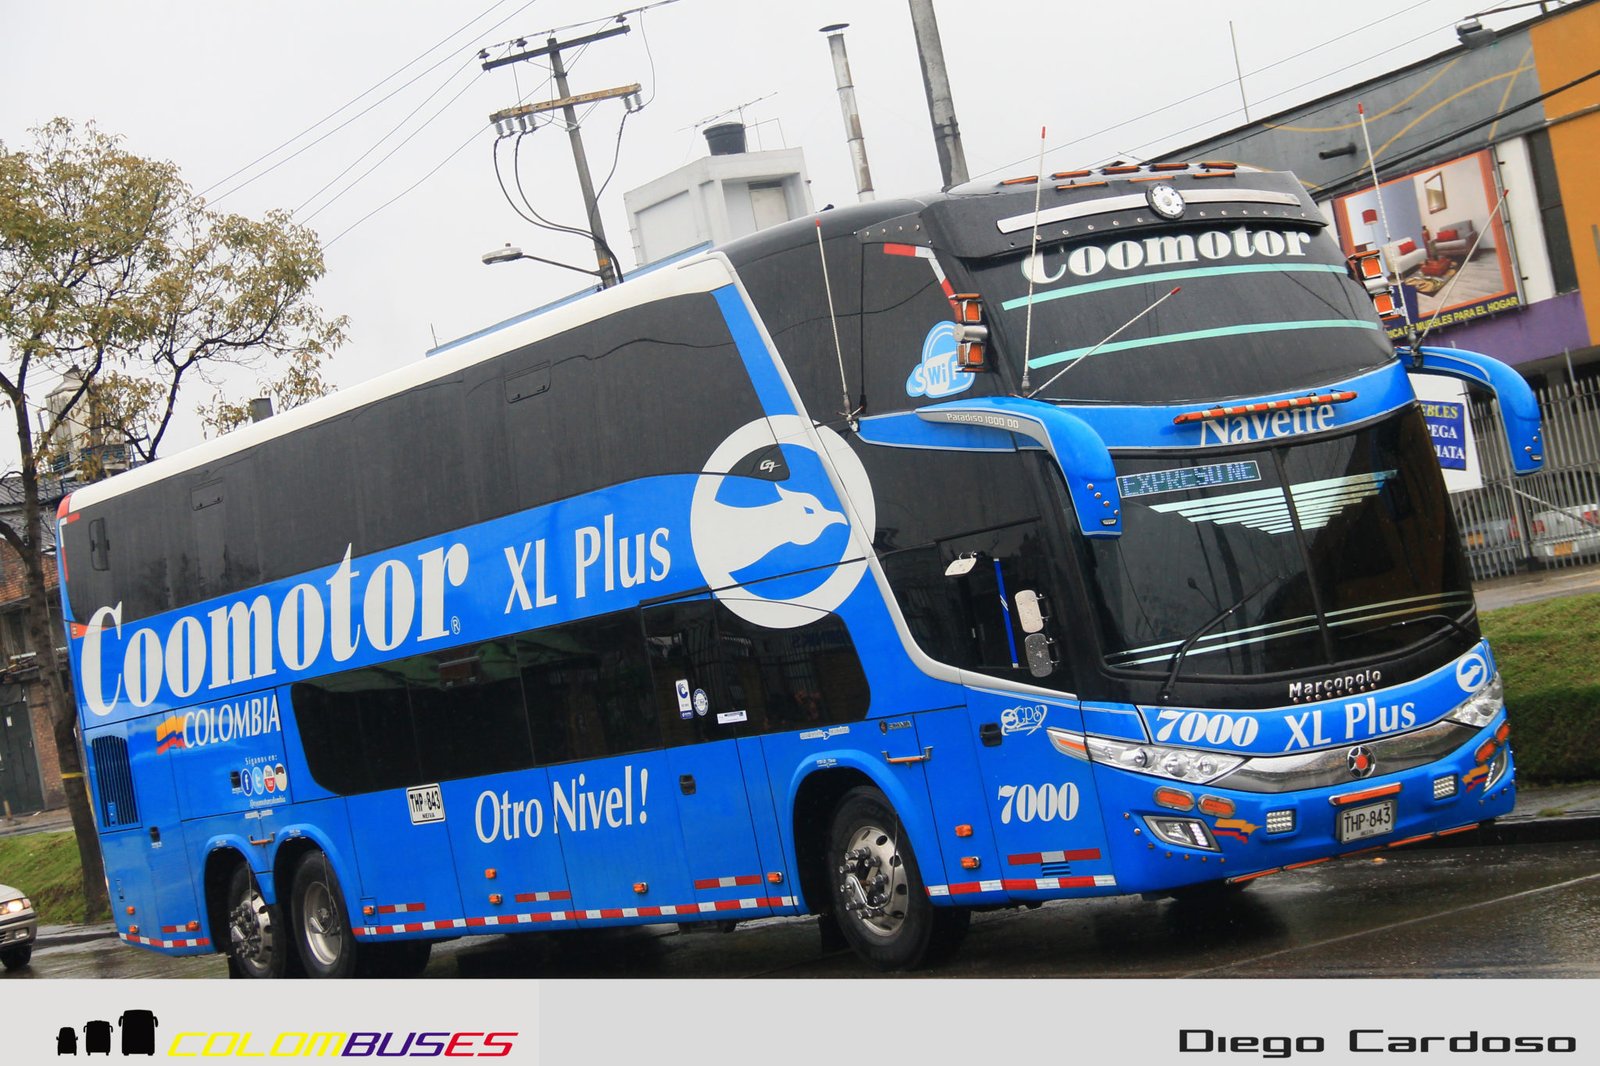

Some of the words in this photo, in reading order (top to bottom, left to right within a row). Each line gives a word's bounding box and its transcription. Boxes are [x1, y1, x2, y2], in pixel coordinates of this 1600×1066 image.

[1021, 225, 1311, 284] Coomotor
[1454, 309, 1476, 321] PARA
[1476, 305, 1487, 315] EL
[1487, 296, 1518, 311] HOGAR
[946, 413, 983, 423] Paradiso
[1200, 405, 1335, 447] Navette
[1427, 424, 1458, 439] EGA
[1434, 445, 1465, 459] IATA
[504, 538, 557, 615] XL
[575, 513, 672, 599] Plus
[81, 543, 470, 716] Coomotor
[1289, 669, 1382, 698] Marcopolo
[183, 694, 281, 749] COLOMBIA
[1156, 709, 1260, 747] 7000
[1283, 710, 1332, 751] XL
[1345, 697, 1416, 739] Plus
[475, 790, 543, 843] Otro
[998, 782, 1079, 824] 7000
